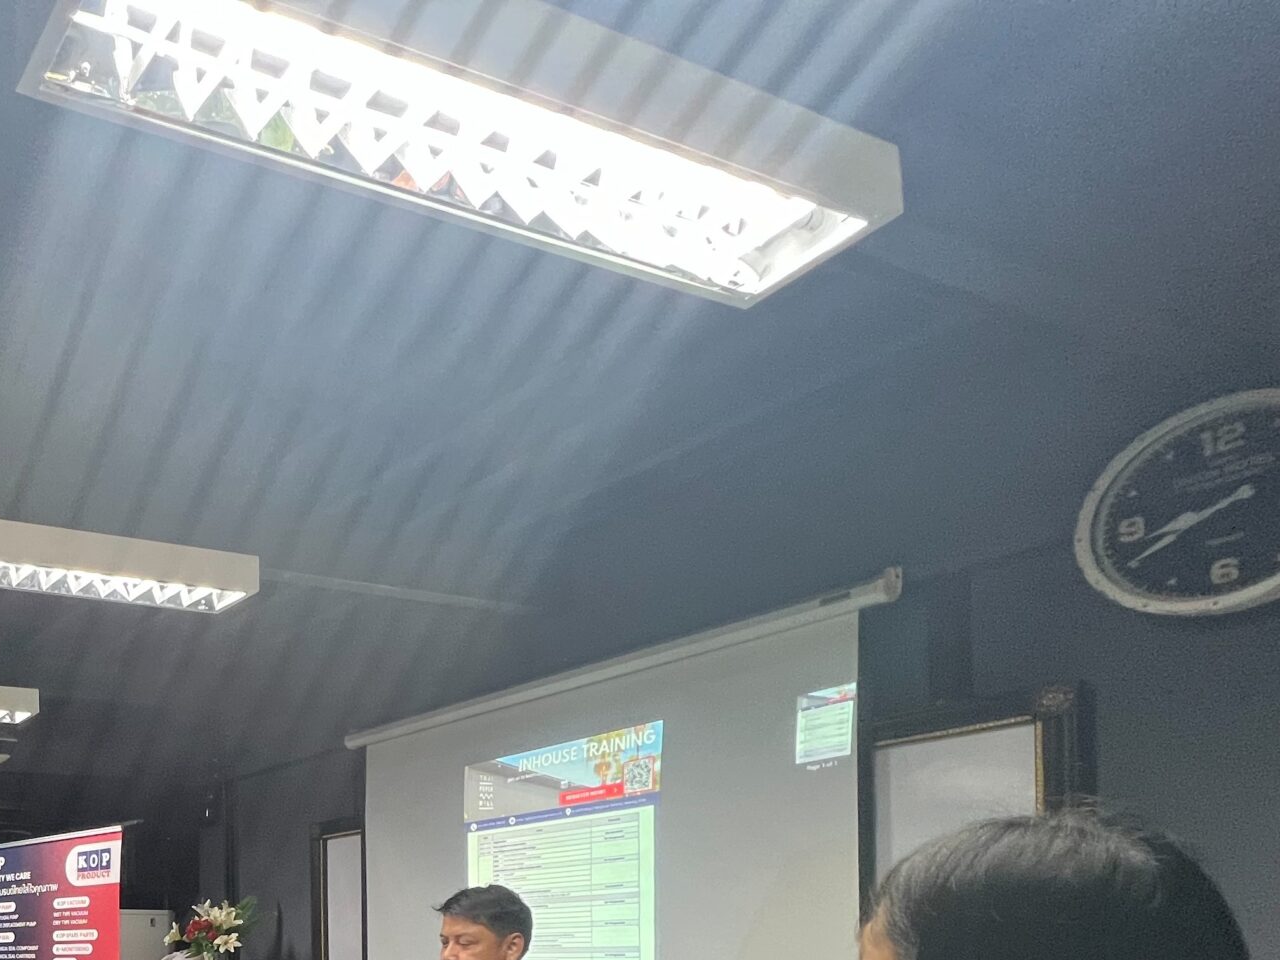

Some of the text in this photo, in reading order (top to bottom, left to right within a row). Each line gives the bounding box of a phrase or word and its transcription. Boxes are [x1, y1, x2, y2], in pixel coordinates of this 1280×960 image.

[1200, 421, 1245, 456] 12
[1120, 516, 1144, 542] 9
[1210, 557, 1240, 584] 6
[518, 729, 656, 772] INHOUSE TRAINING
[78, 852, 110, 869] KOP
[15, 872, 31, 880] CARE
[78, 870, 110, 880] PRODUCT
